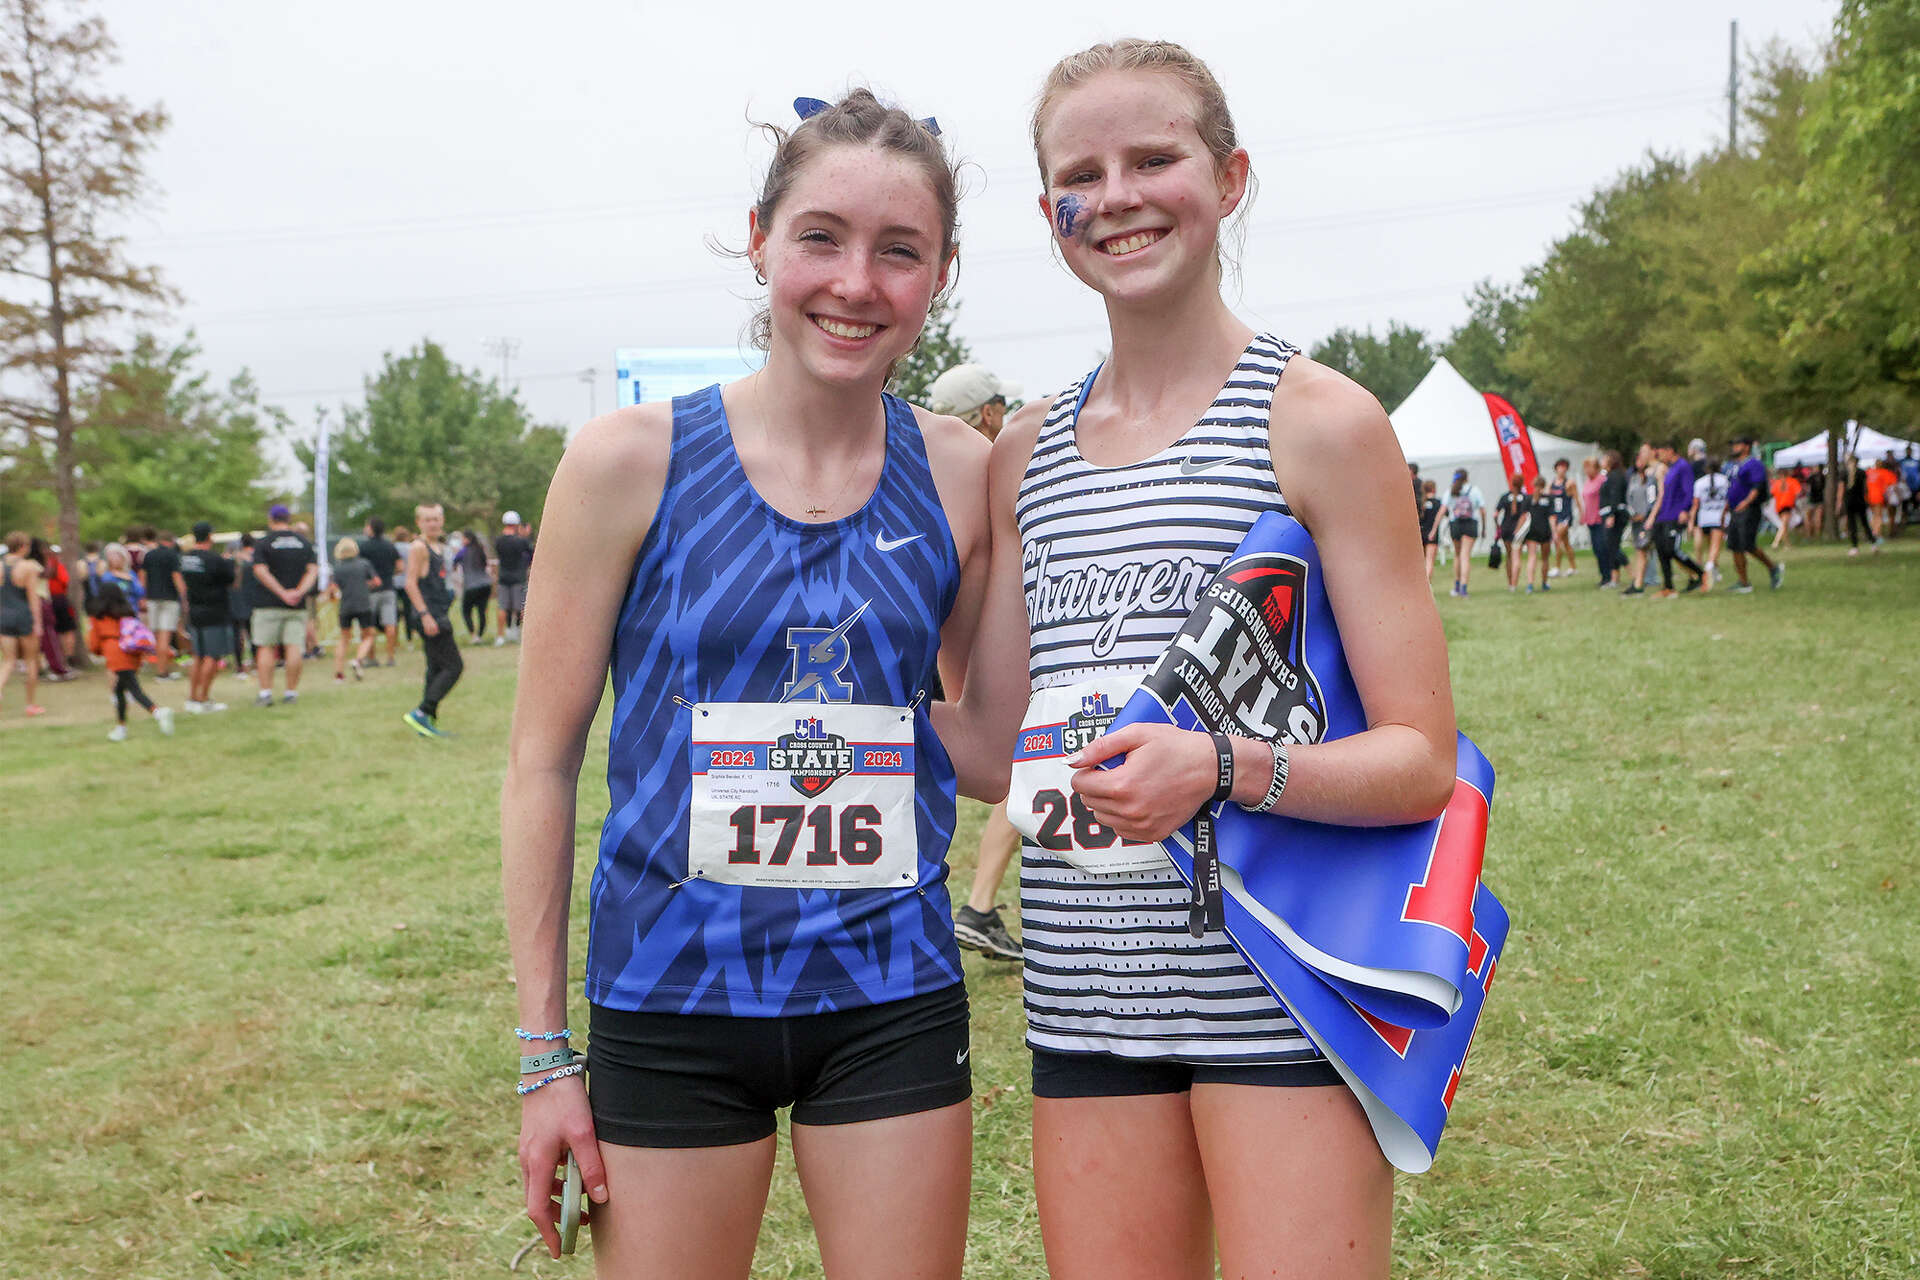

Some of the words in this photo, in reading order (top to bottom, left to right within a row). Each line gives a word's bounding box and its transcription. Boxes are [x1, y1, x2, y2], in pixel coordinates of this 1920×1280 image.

[1207, 582, 1299, 692] CHAMPIONSHIPS
[1175, 605, 1319, 745] STAT
[1173, 658, 1225, 722] COUNTRY
[1096, 717, 1115, 725] COUNT
[1024, 733, 1053, 753] 2024
[1064, 727, 1106, 749] STA
[711, 750, 755, 767] 2024
[770, 749, 852, 769] STATE
[864, 751, 902, 767] 2024
[791, 769, 837, 777] HAMPIONSHIPS
[1031, 788, 1154, 851] 28
[727, 803, 883, 867] 1716
